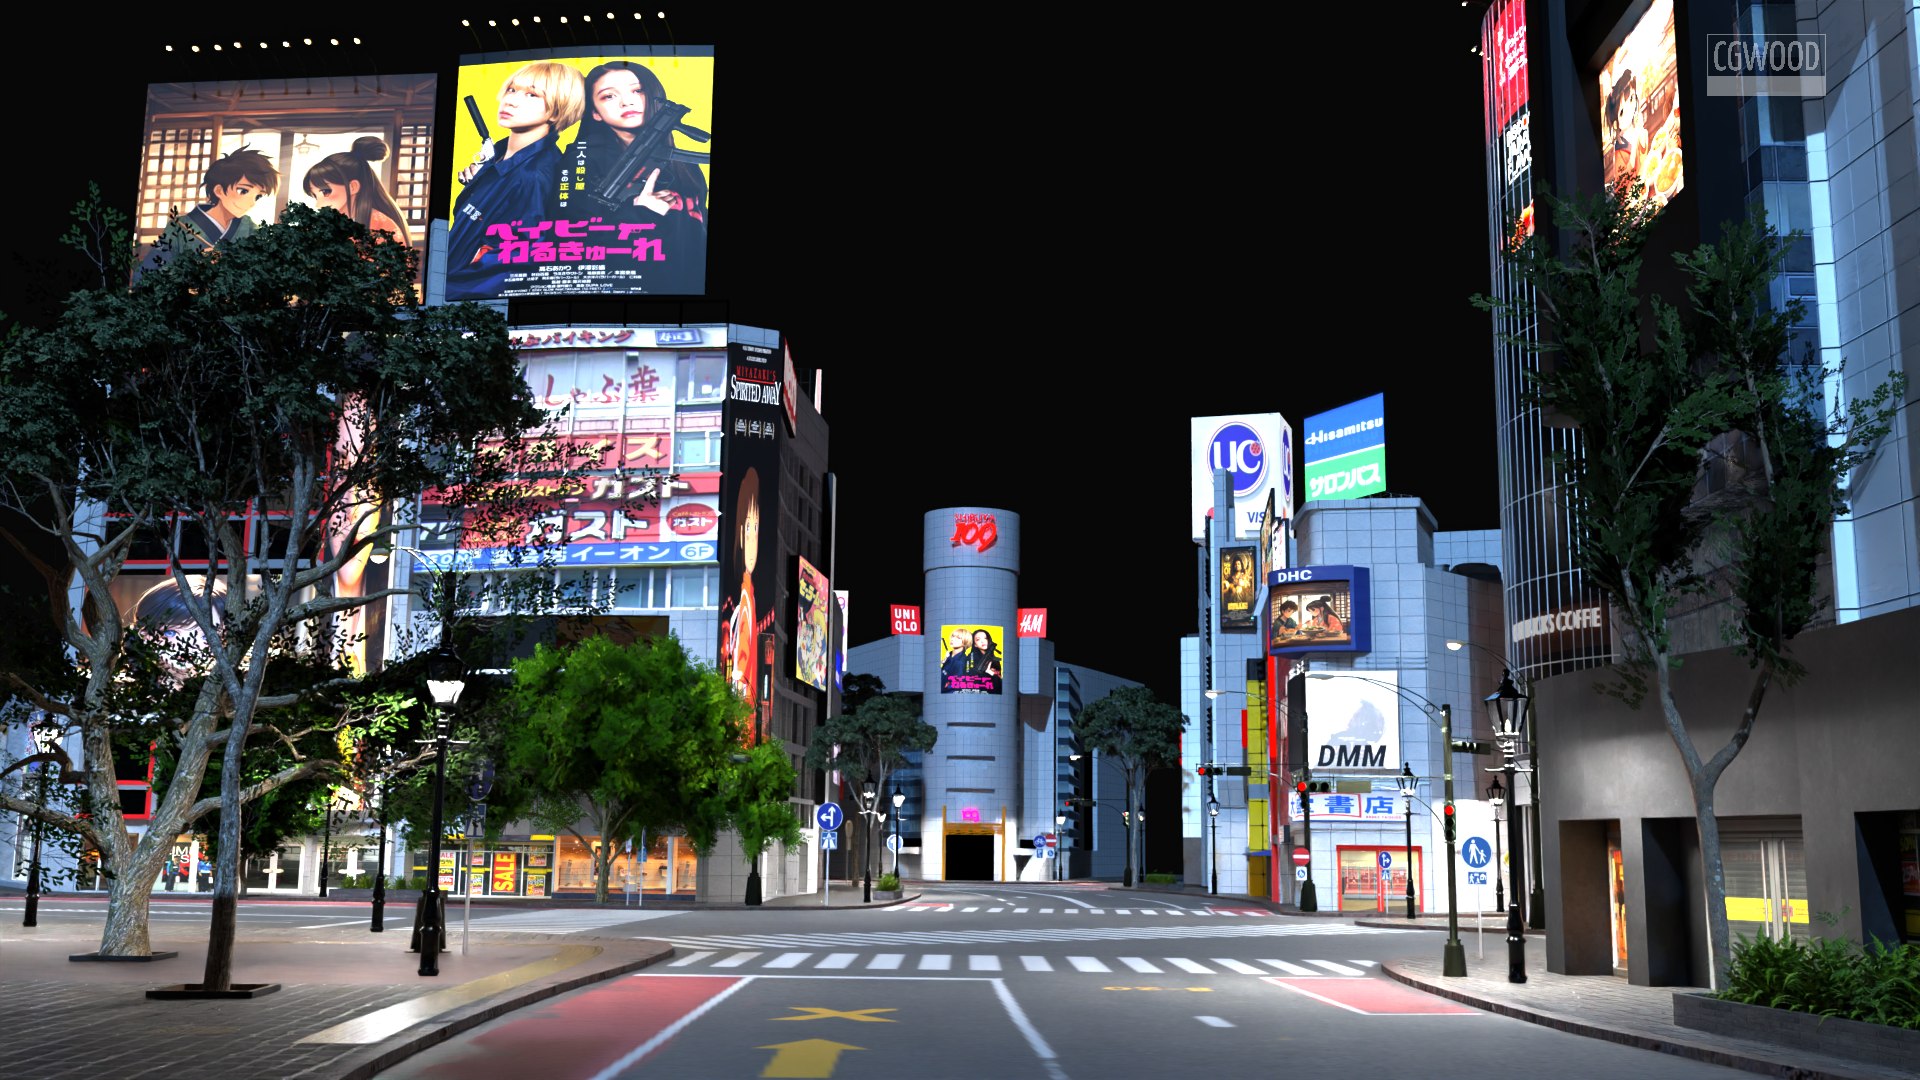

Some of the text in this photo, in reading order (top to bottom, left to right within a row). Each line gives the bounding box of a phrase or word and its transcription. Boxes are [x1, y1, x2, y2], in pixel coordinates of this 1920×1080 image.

[575, 141, 587, 191] 二人は殺し屋
[559, 169, 570, 208] その正体は
[498, 237, 666, 264] わるきゅーれ
[546, 365, 660, 406] しゃぶ葉
[1305, 416, 1384, 445] Hisamitsu
[1309, 462, 1382, 498] サロンパス
[525, 509, 649, 544] ガスト
[672, 517, 713, 528] ガスト
[950, 521, 997, 553] 109
[685, 546, 710, 557] 6F
[1278, 569, 1312, 583] DHC
[894, 620, 917, 632] QLO
[895, 608, 915, 619] UNI
[1019, 613, 1044, 633] H&M
[1317, 744, 1387, 767] DMM
[493, 853, 515, 891] SALE
